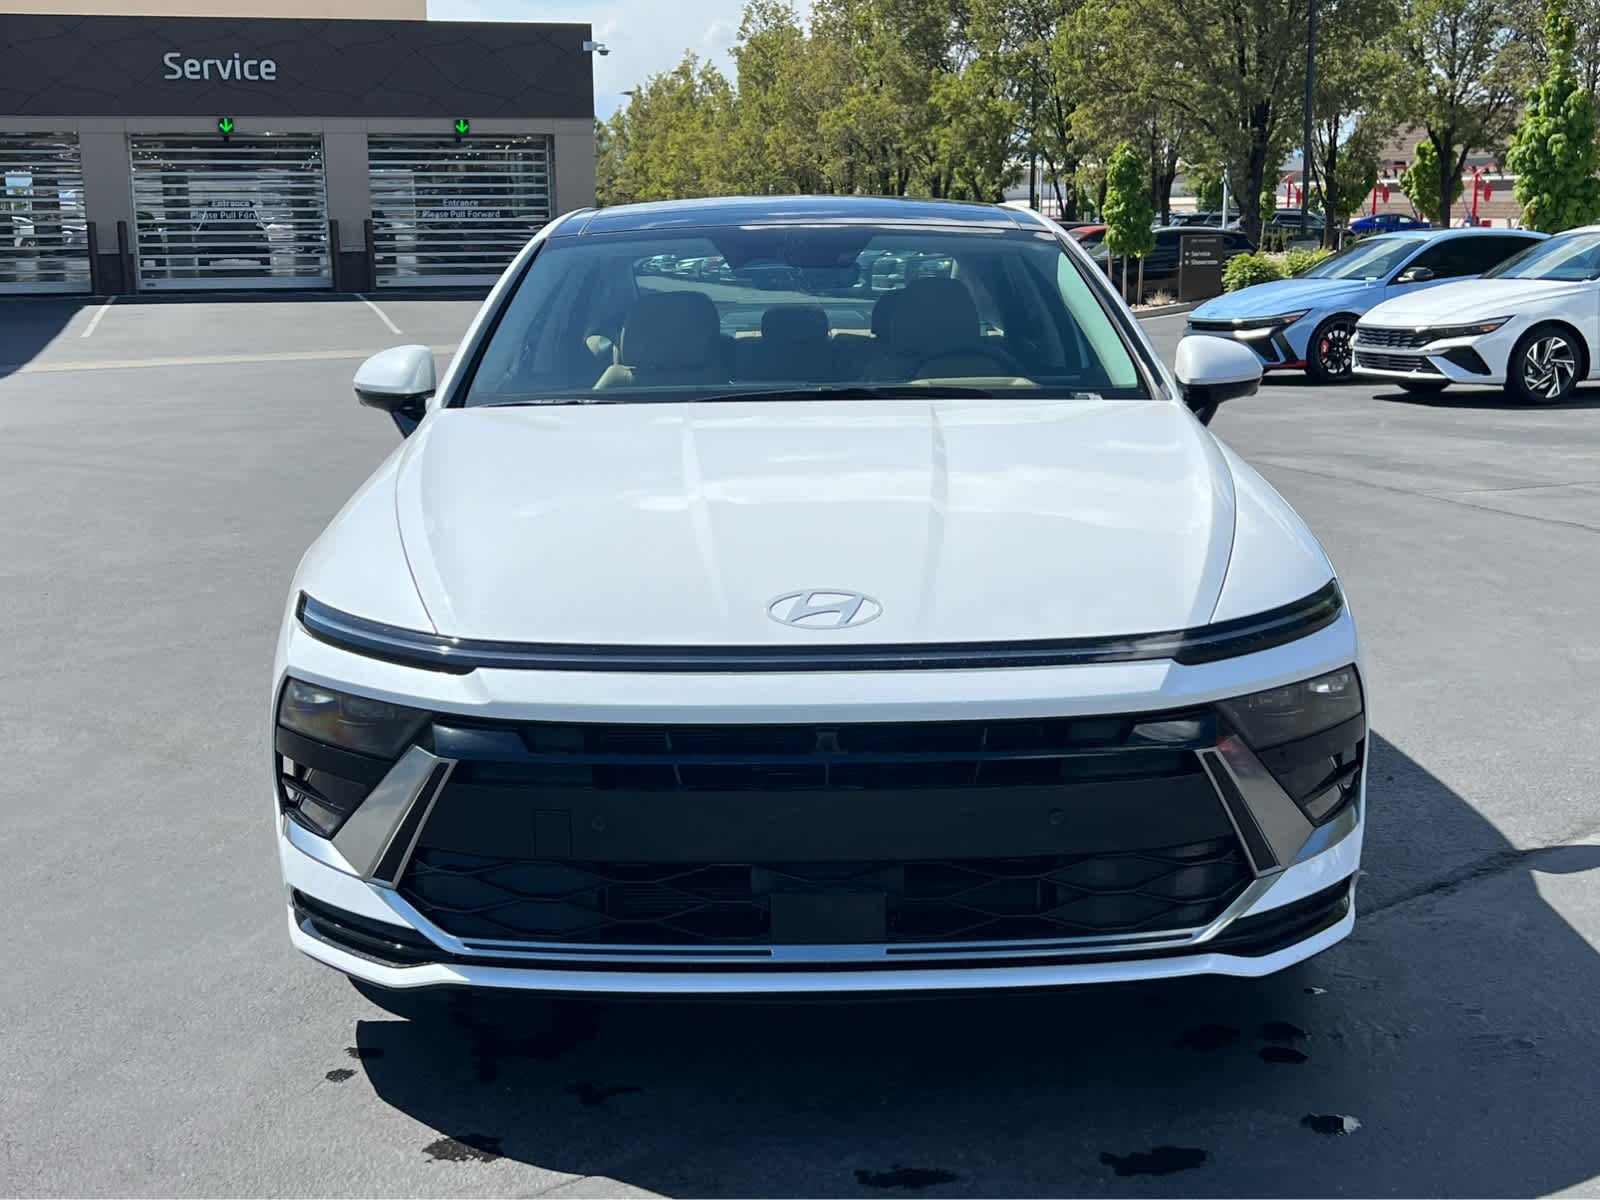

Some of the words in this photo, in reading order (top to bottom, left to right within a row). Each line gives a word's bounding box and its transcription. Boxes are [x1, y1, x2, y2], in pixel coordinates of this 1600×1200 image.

[163, 51, 277, 81] Service
[210, 200, 251, 208] Entrance
[443, 199, 479, 208] Entrance
[220, 210, 237, 219] Pull
[422, 209, 449, 218] Please
[450, 209, 466, 218] Pull
[467, 209, 501, 218] Forward
